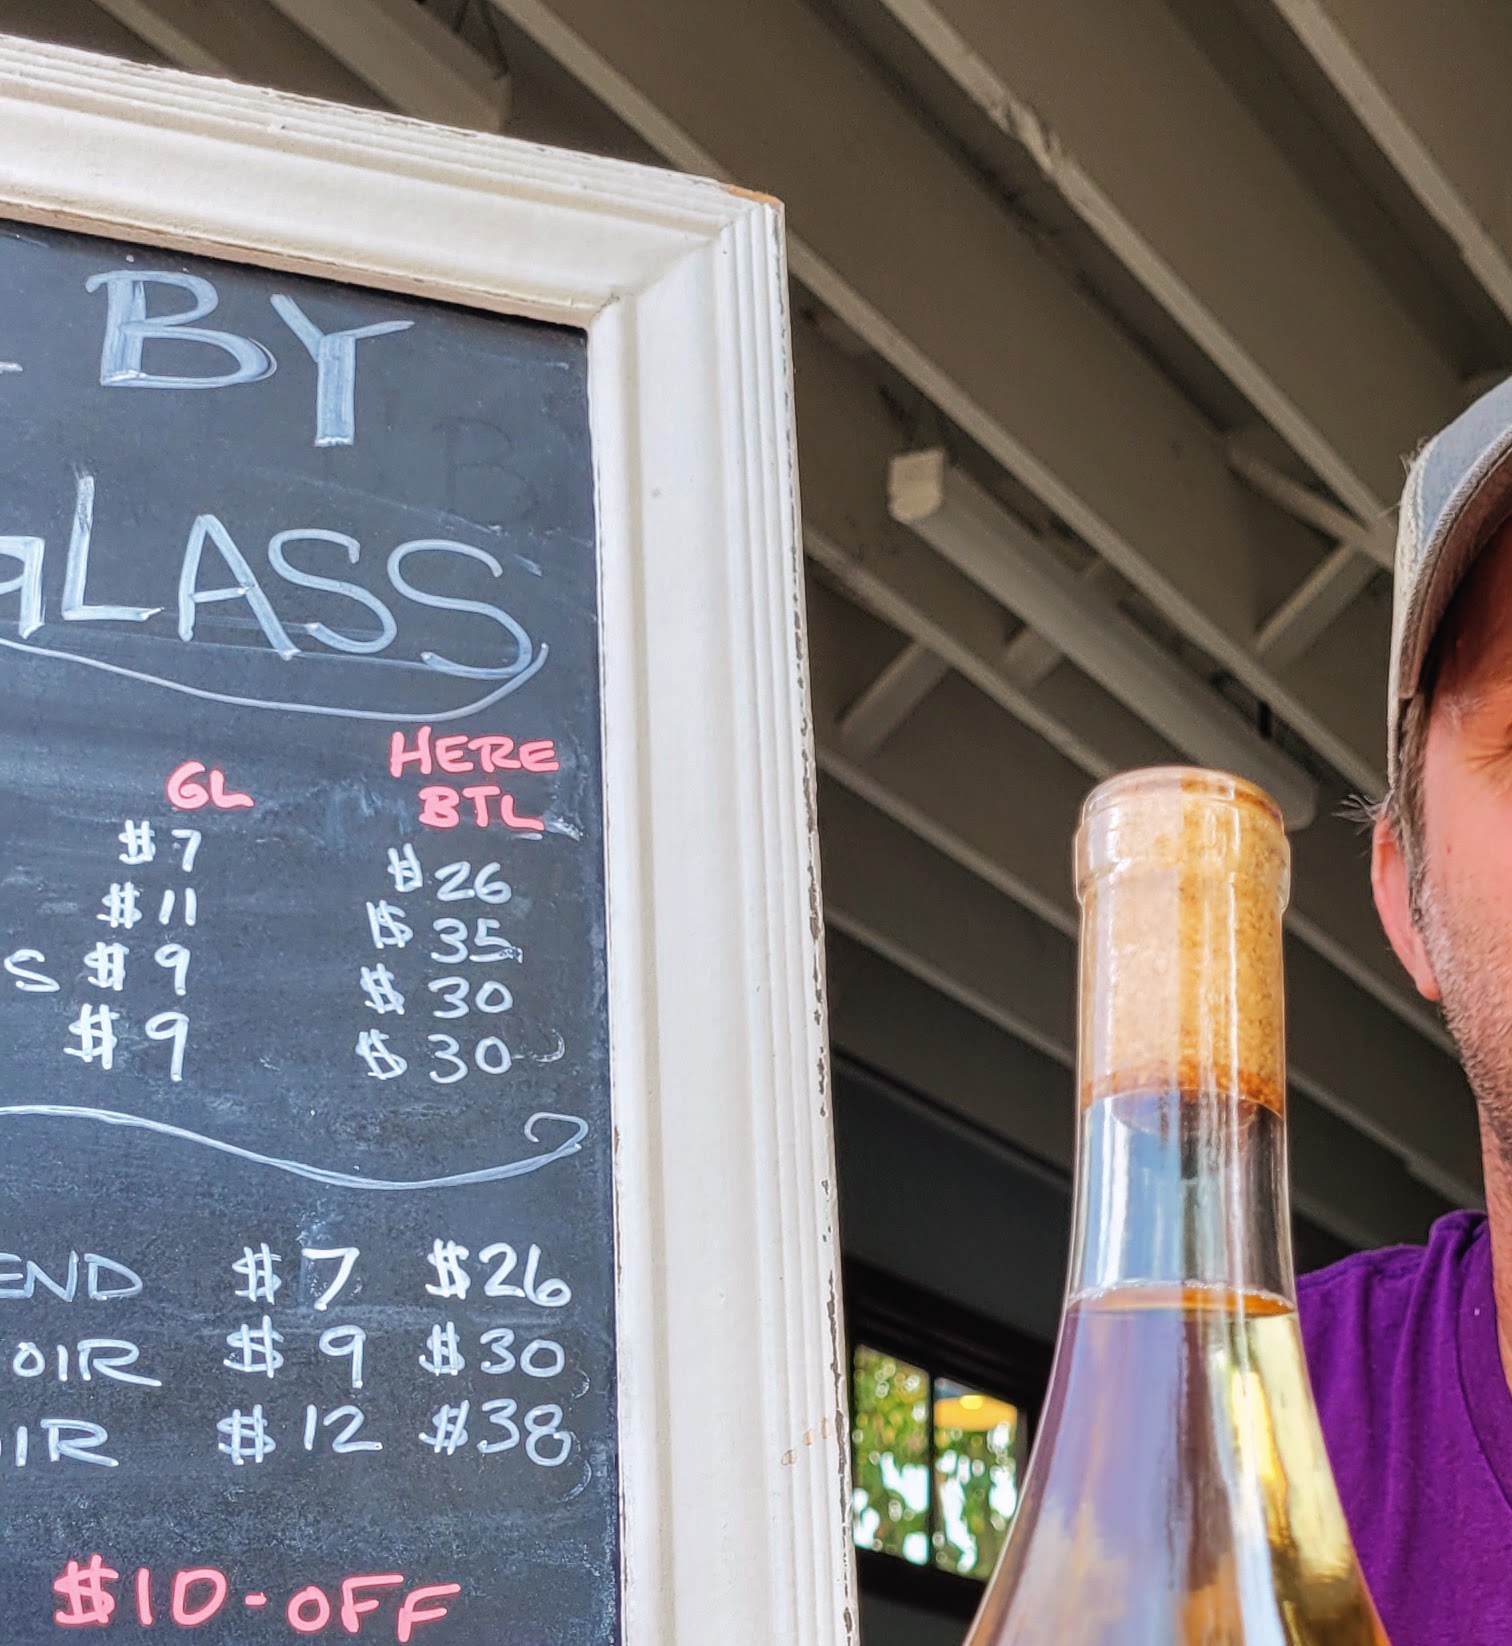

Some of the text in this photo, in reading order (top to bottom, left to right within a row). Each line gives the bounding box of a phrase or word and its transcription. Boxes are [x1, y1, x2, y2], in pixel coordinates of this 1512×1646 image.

[85, 269, 416, 447] BY
[166, 761, 254, 812] GL
[388, 725, 560, 778] HERE
[417, 784, 546, 831] BTL
[118, 819, 512, 903] $7 $26
[96, 881, 514, 964] $11 $35
[83, 941, 191, 995] $9
[359, 962, 513, 1019] $30
[63, 1003, 512, 1084] $9 $30
[231, 1241, 360, 1312] $7
[425, 1238, 572, 1307] $26
[223, 1314, 367, 1389] $9
[418, 1320, 566, 1379] $30
[216, 1403, 383, 1465] $12
[418, 1398, 573, 1467] $38
